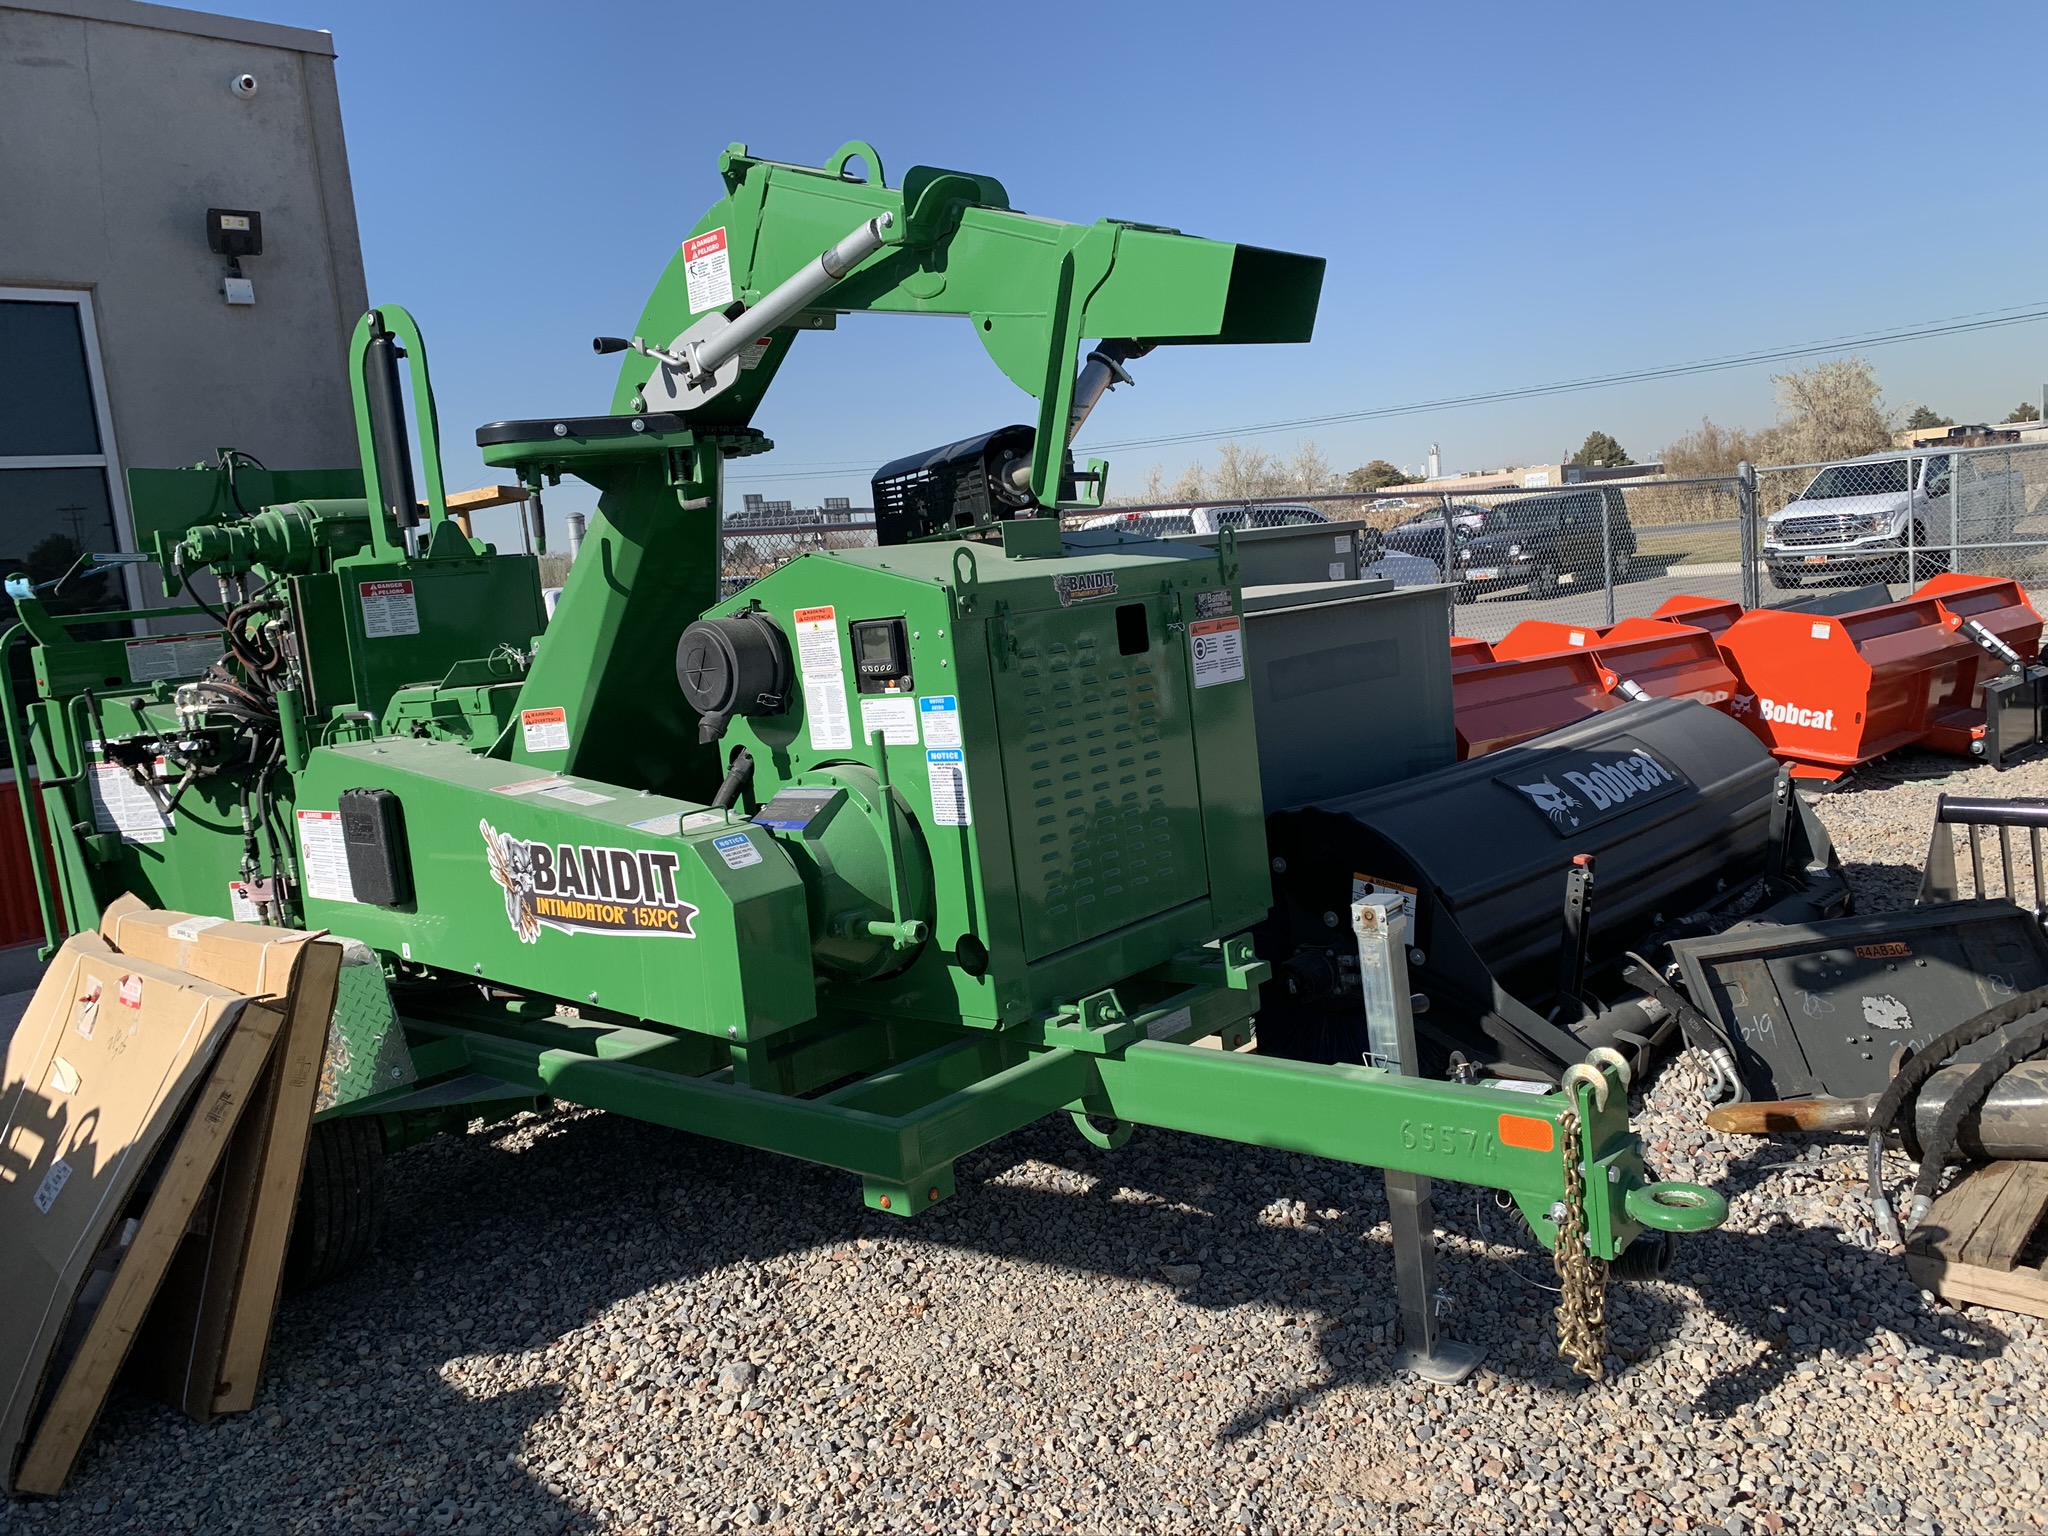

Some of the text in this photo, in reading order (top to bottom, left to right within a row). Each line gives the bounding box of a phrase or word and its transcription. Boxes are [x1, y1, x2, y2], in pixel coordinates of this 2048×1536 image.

[696, 234, 718, 247] DANGER
[697, 243, 720, 256] PELIGRO
[1070, 572, 1114, 590] BANDIT
[1760, 698, 1834, 731] Bobcat
[930, 752, 959, 760] NOTICE
[1562, 748, 1683, 811] Bobcat
[719, 836, 745, 847] NOTICE
[529, 844, 678, 905] BANDIT
[1375, 879, 1405, 891] WARNING
[632, 908, 679, 930] 15XPC
[1400, 1119, 1499, 1165] 65574
